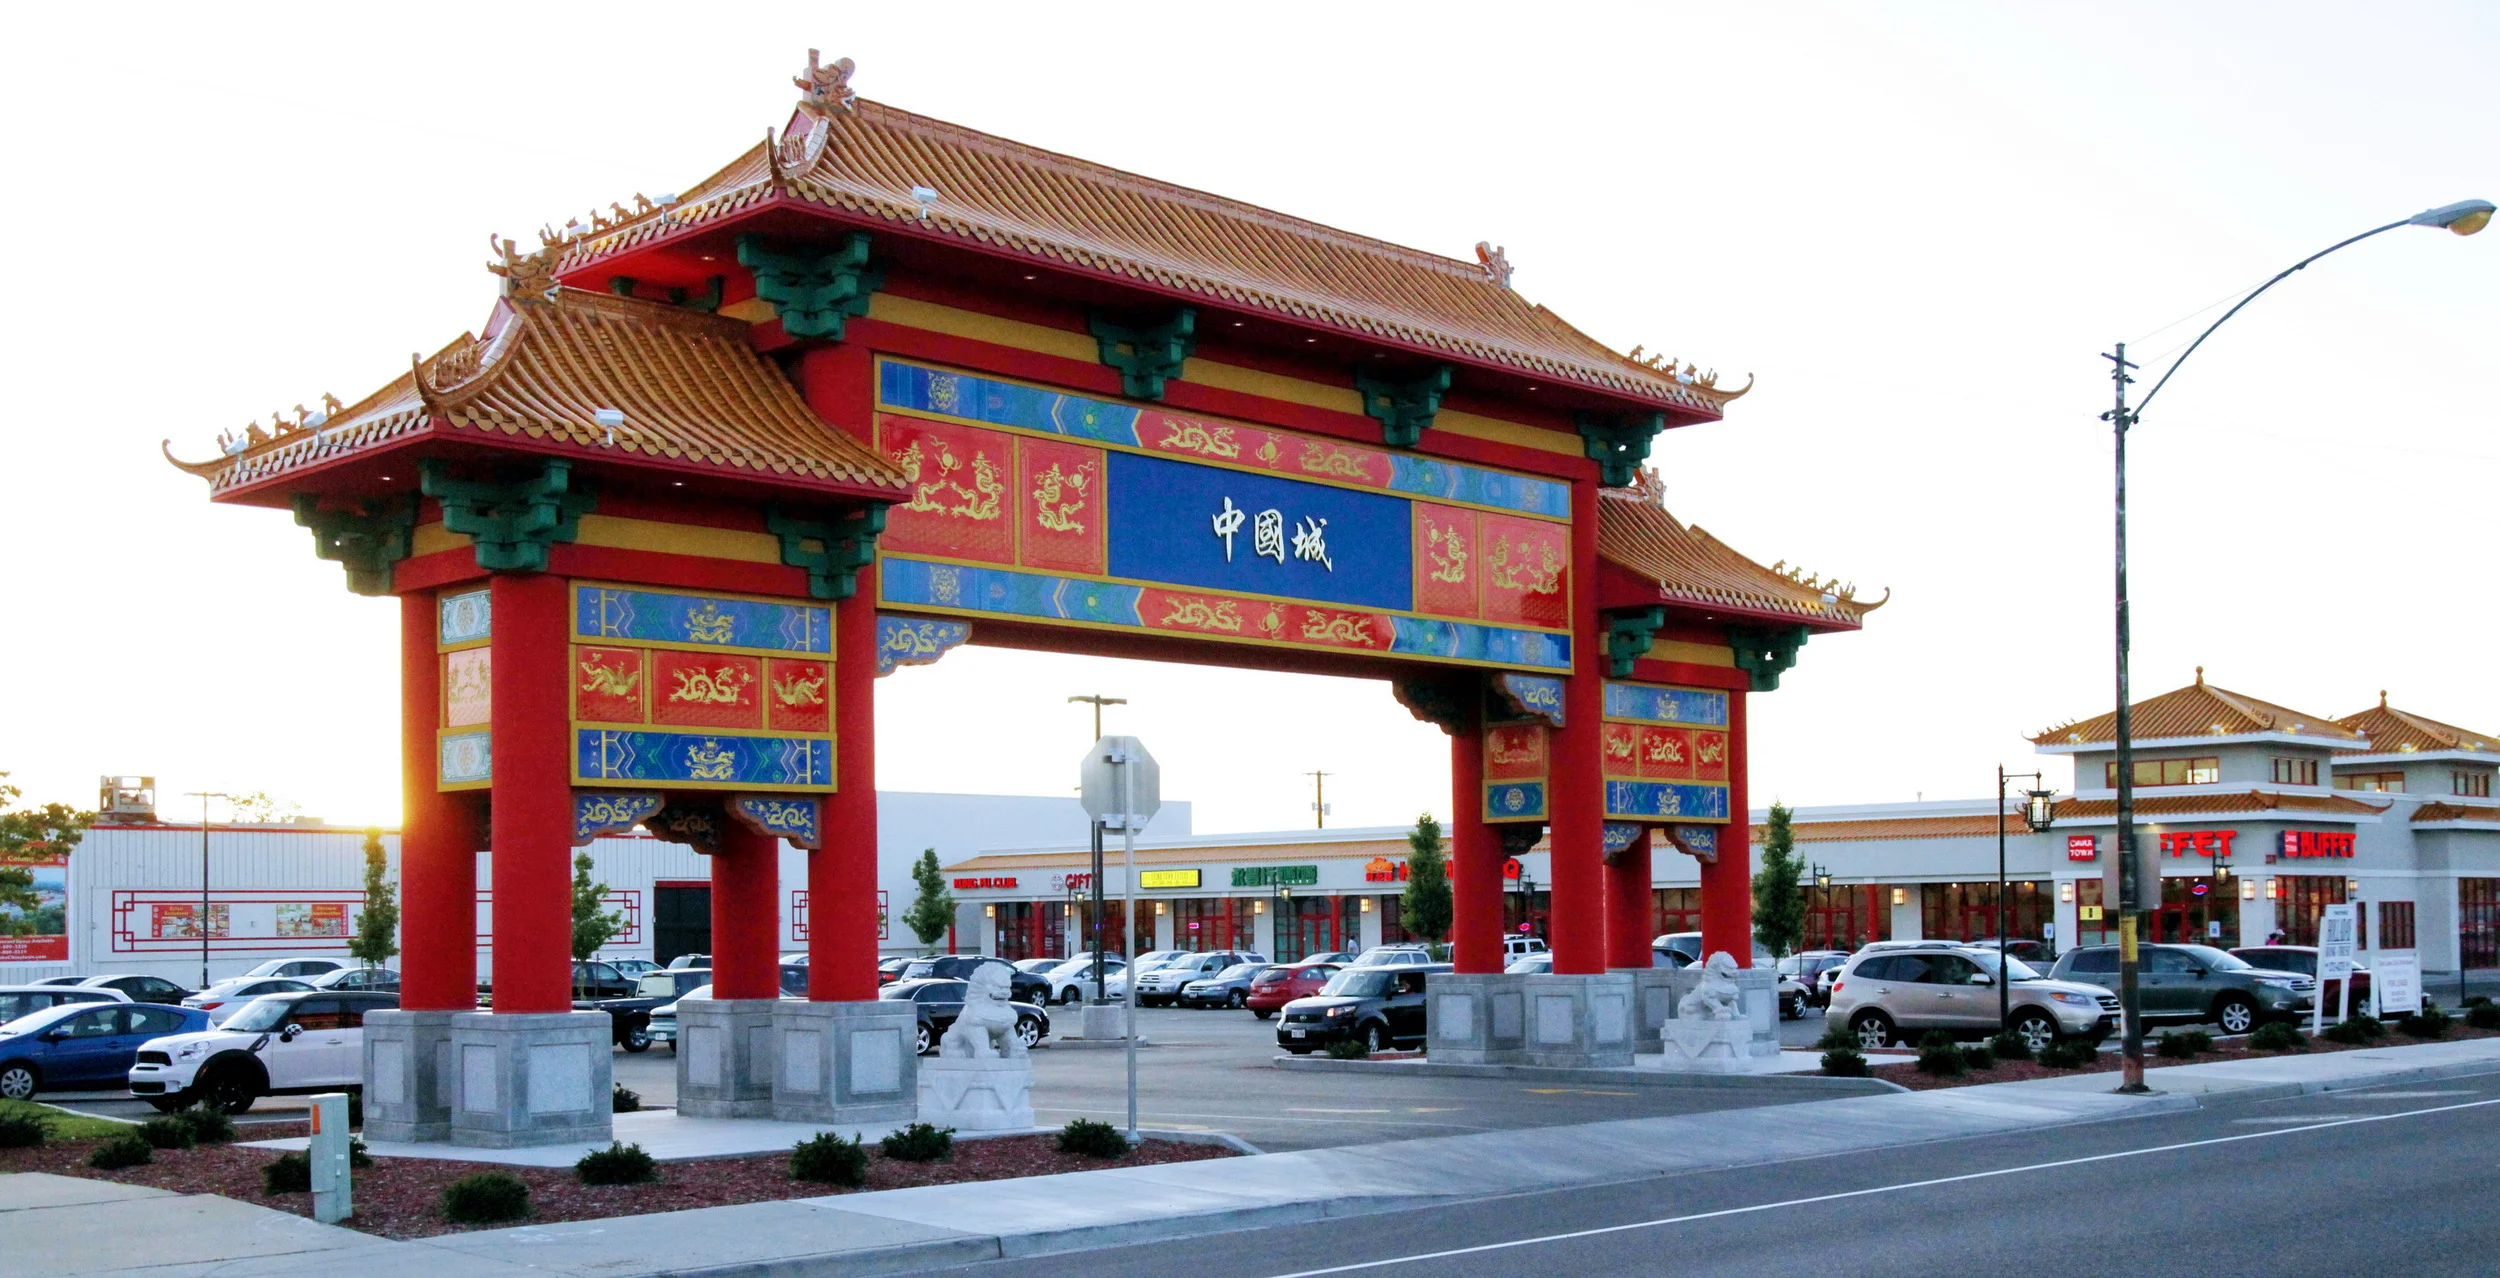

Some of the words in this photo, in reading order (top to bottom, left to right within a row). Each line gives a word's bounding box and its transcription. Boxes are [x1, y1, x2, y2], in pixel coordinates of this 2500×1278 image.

[1212, 496, 1333, 573] 中國城
[2301, 831, 2357, 857] BUFFET
[2069, 849, 2094, 857] TOWN
[953, 878, 978, 889] KUNG
[979, 878, 992, 889] FU
[993, 877, 1018, 888] CLUB
[1065, 873, 1097, 890] GIFT
